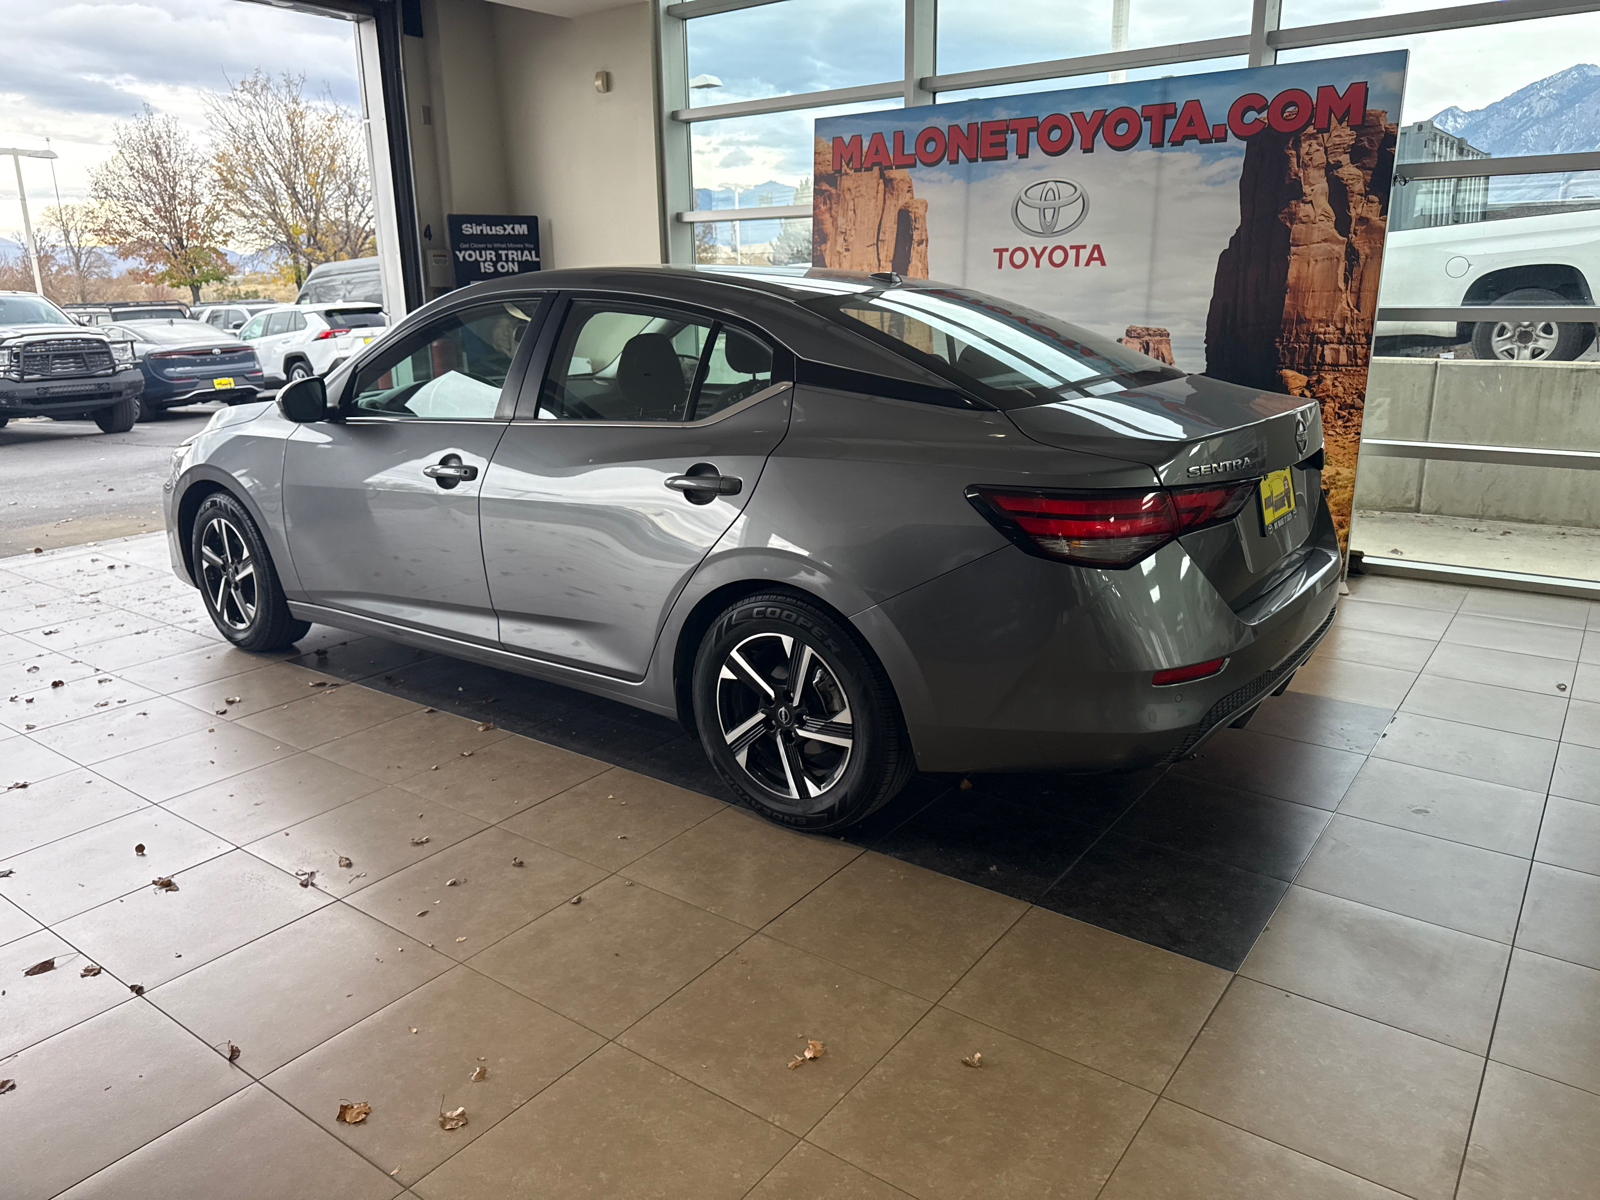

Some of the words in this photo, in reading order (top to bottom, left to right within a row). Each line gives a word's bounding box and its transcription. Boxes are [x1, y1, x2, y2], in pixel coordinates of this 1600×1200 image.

[832, 81, 1368, 174] MALONETOYOTA.COM
[461, 223, 529, 235] SiriusXM
[455, 250, 496, 262] YOUR
[498, 250, 540, 262] TRIAL
[480, 261, 495, 273] IS
[496, 261, 519, 273] ON
[993, 244, 1107, 270] TOYOTA
[1187, 457, 1251, 478] SENTRA
[752, 606, 841, 655] COOPER
[723, 773, 807, 826] ENDEAVOR
